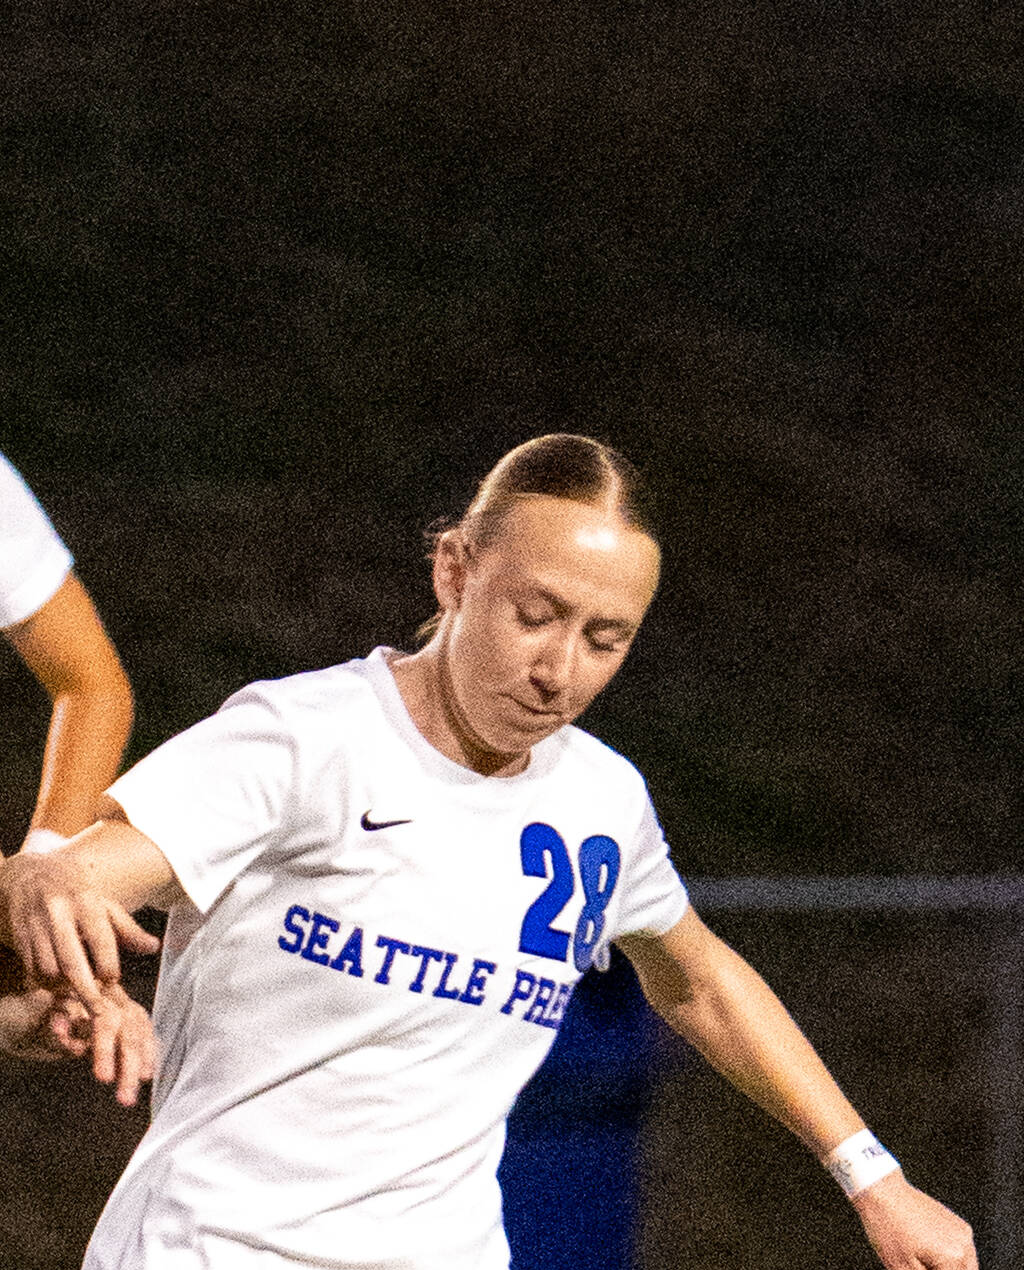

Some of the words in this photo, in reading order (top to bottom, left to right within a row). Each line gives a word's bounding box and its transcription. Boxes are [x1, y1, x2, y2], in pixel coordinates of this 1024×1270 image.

[518, 821, 621, 972] 28
[278, 904, 496, 1006] SEATTLE
[500, 968, 573, 1030] PRE
